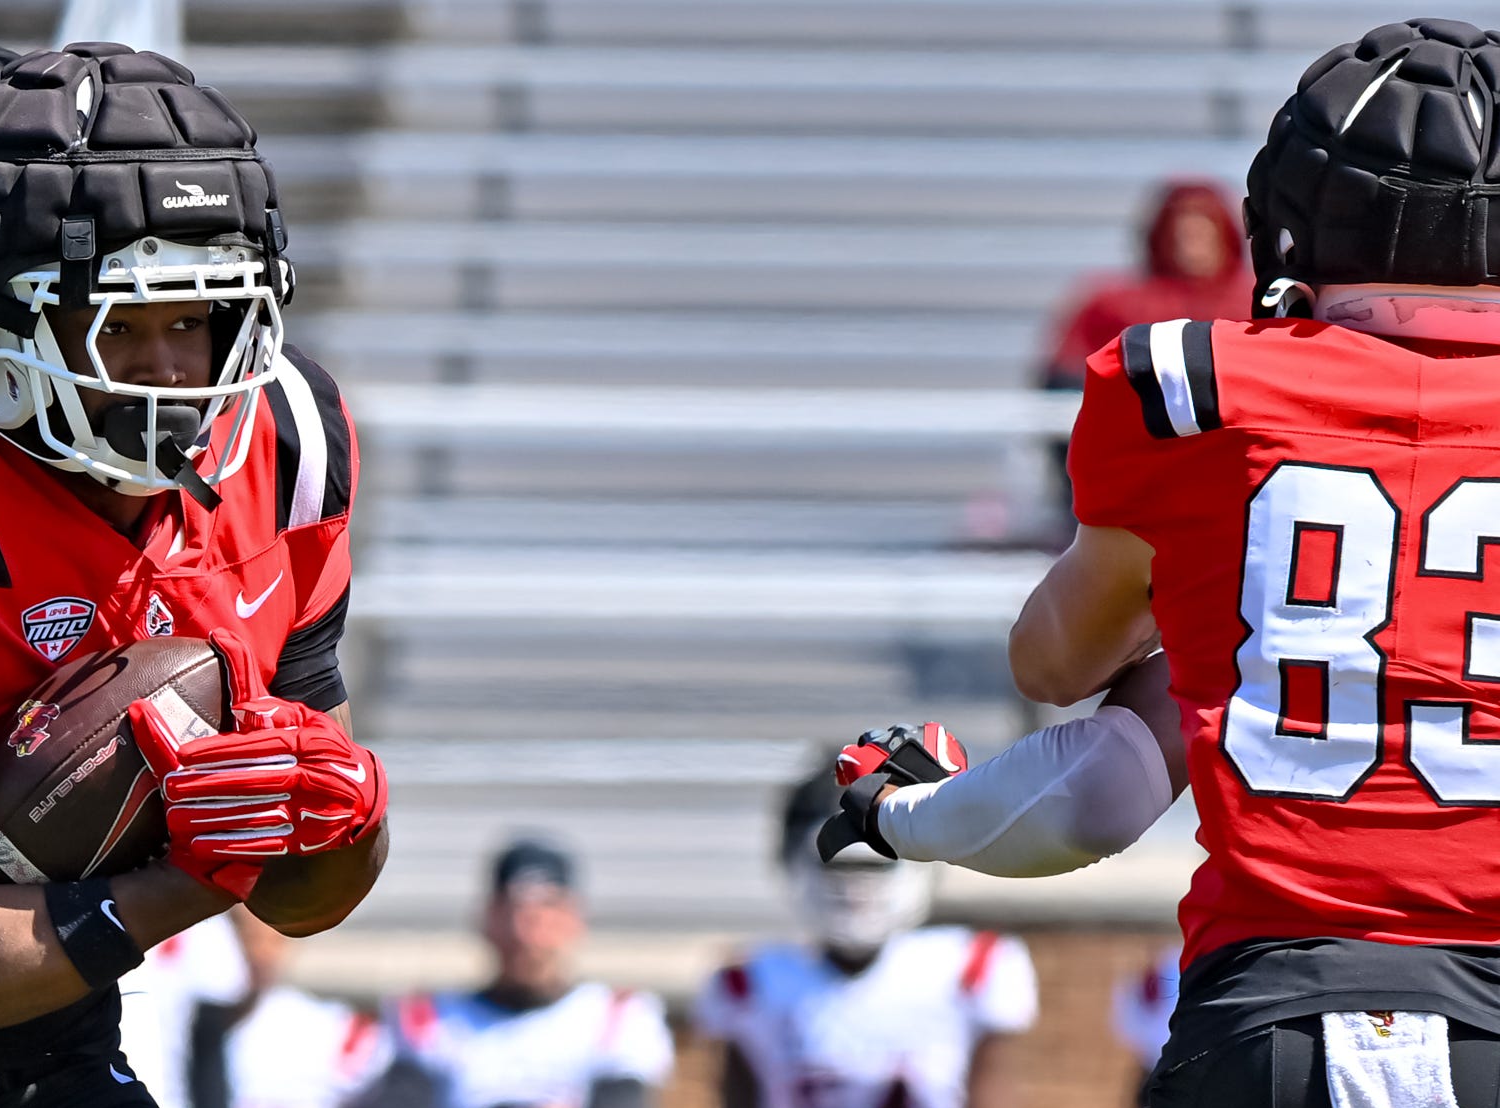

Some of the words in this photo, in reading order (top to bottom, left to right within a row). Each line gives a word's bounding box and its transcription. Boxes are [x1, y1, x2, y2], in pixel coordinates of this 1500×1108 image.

[162, 194, 229, 208] GUARDIAN
[48, 607, 69, 617] 1946
[27, 618, 88, 642] MAC
[1218, 459, 1500, 808] 83
